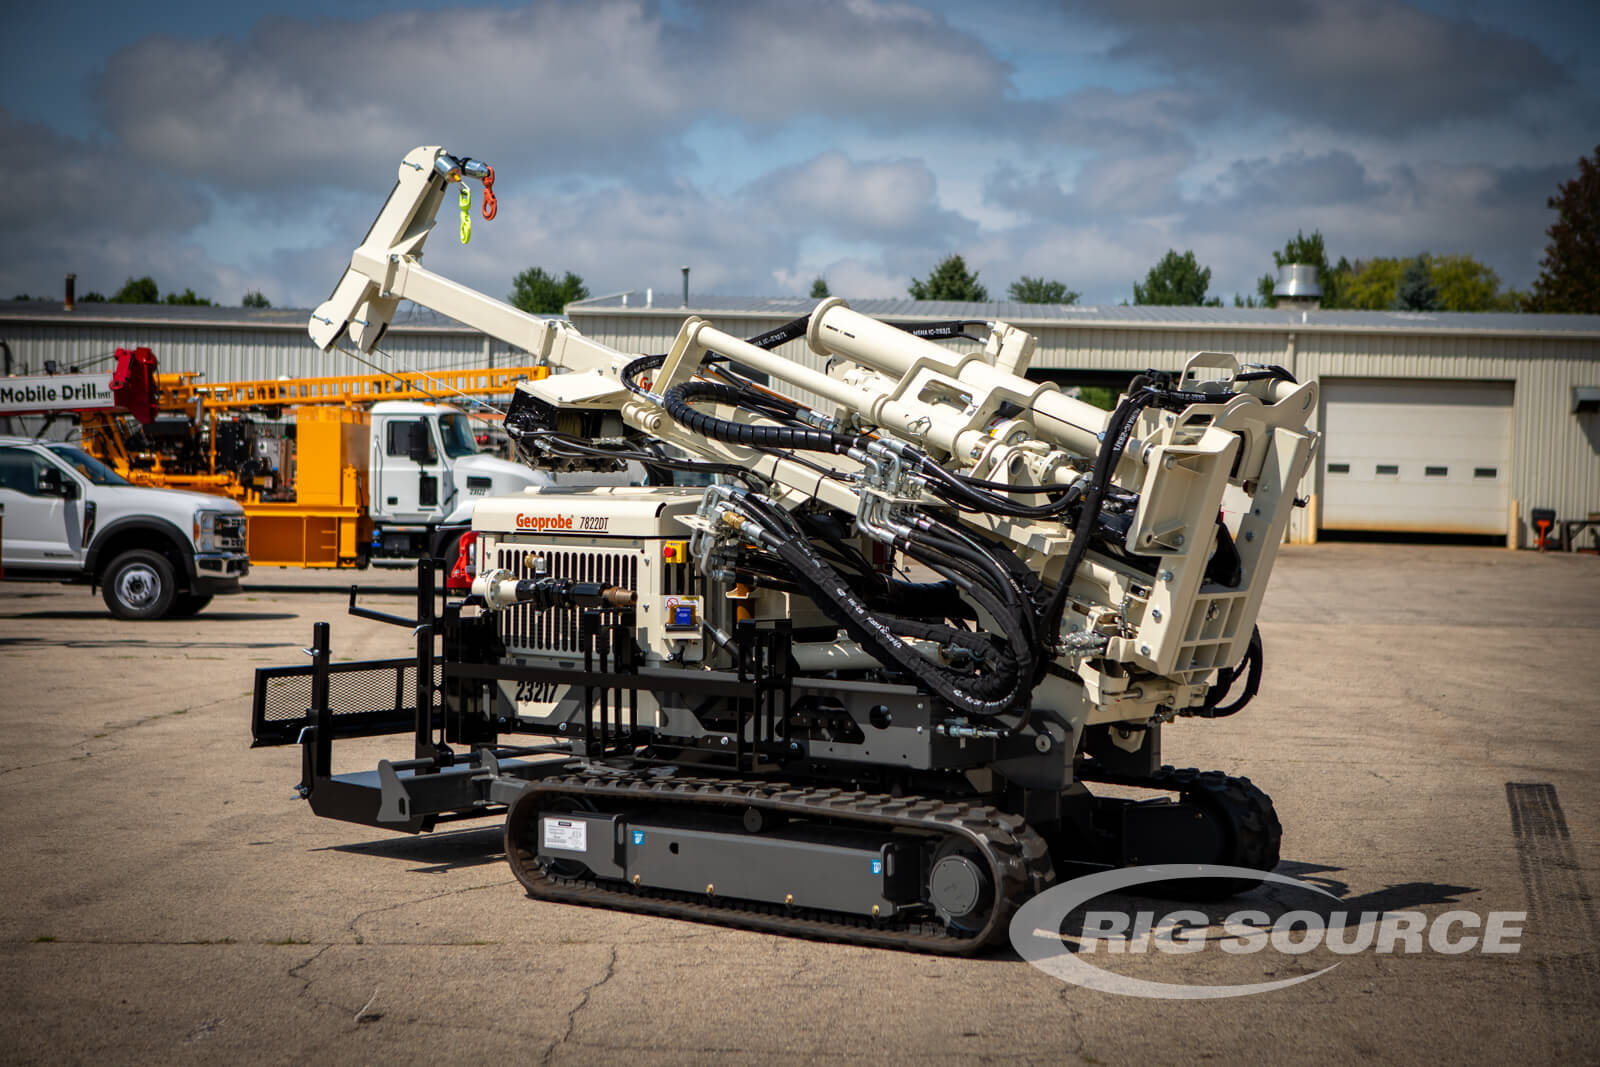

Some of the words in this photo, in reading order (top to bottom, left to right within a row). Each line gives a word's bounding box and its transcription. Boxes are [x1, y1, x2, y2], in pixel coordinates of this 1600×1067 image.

[0, 384, 57, 403] Mobile
[62, 382, 96, 400] Drill
[516, 513, 573, 532] Geoprobe
[580, 516, 609, 530] 7822DT
[515, 680, 559, 703] 23217
